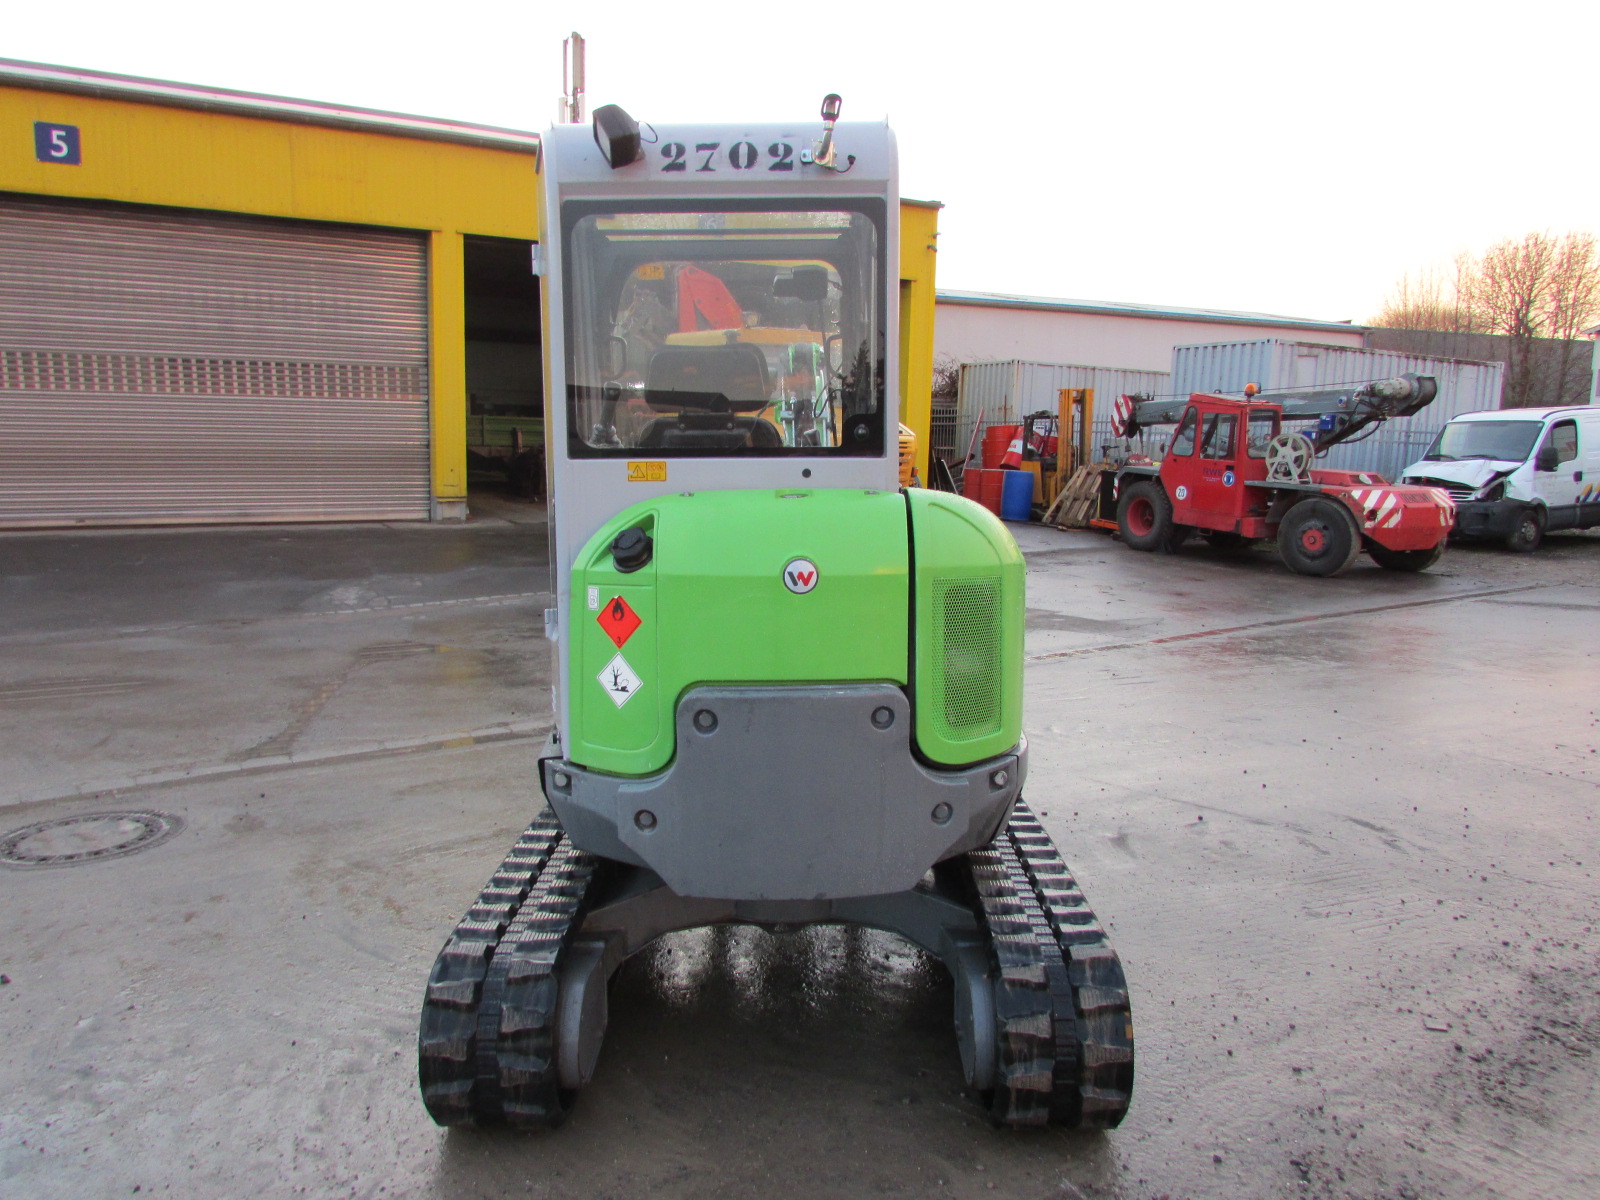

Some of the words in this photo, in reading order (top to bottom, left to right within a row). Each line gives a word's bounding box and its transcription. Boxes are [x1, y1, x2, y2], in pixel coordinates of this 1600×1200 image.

[51, 129, 68, 157] 5
[660, 141, 794, 172] 2702
[1203, 467, 1223, 477] RWE
[1177, 488, 1185, 498] 20
[616, 636, 622, 644] 3
